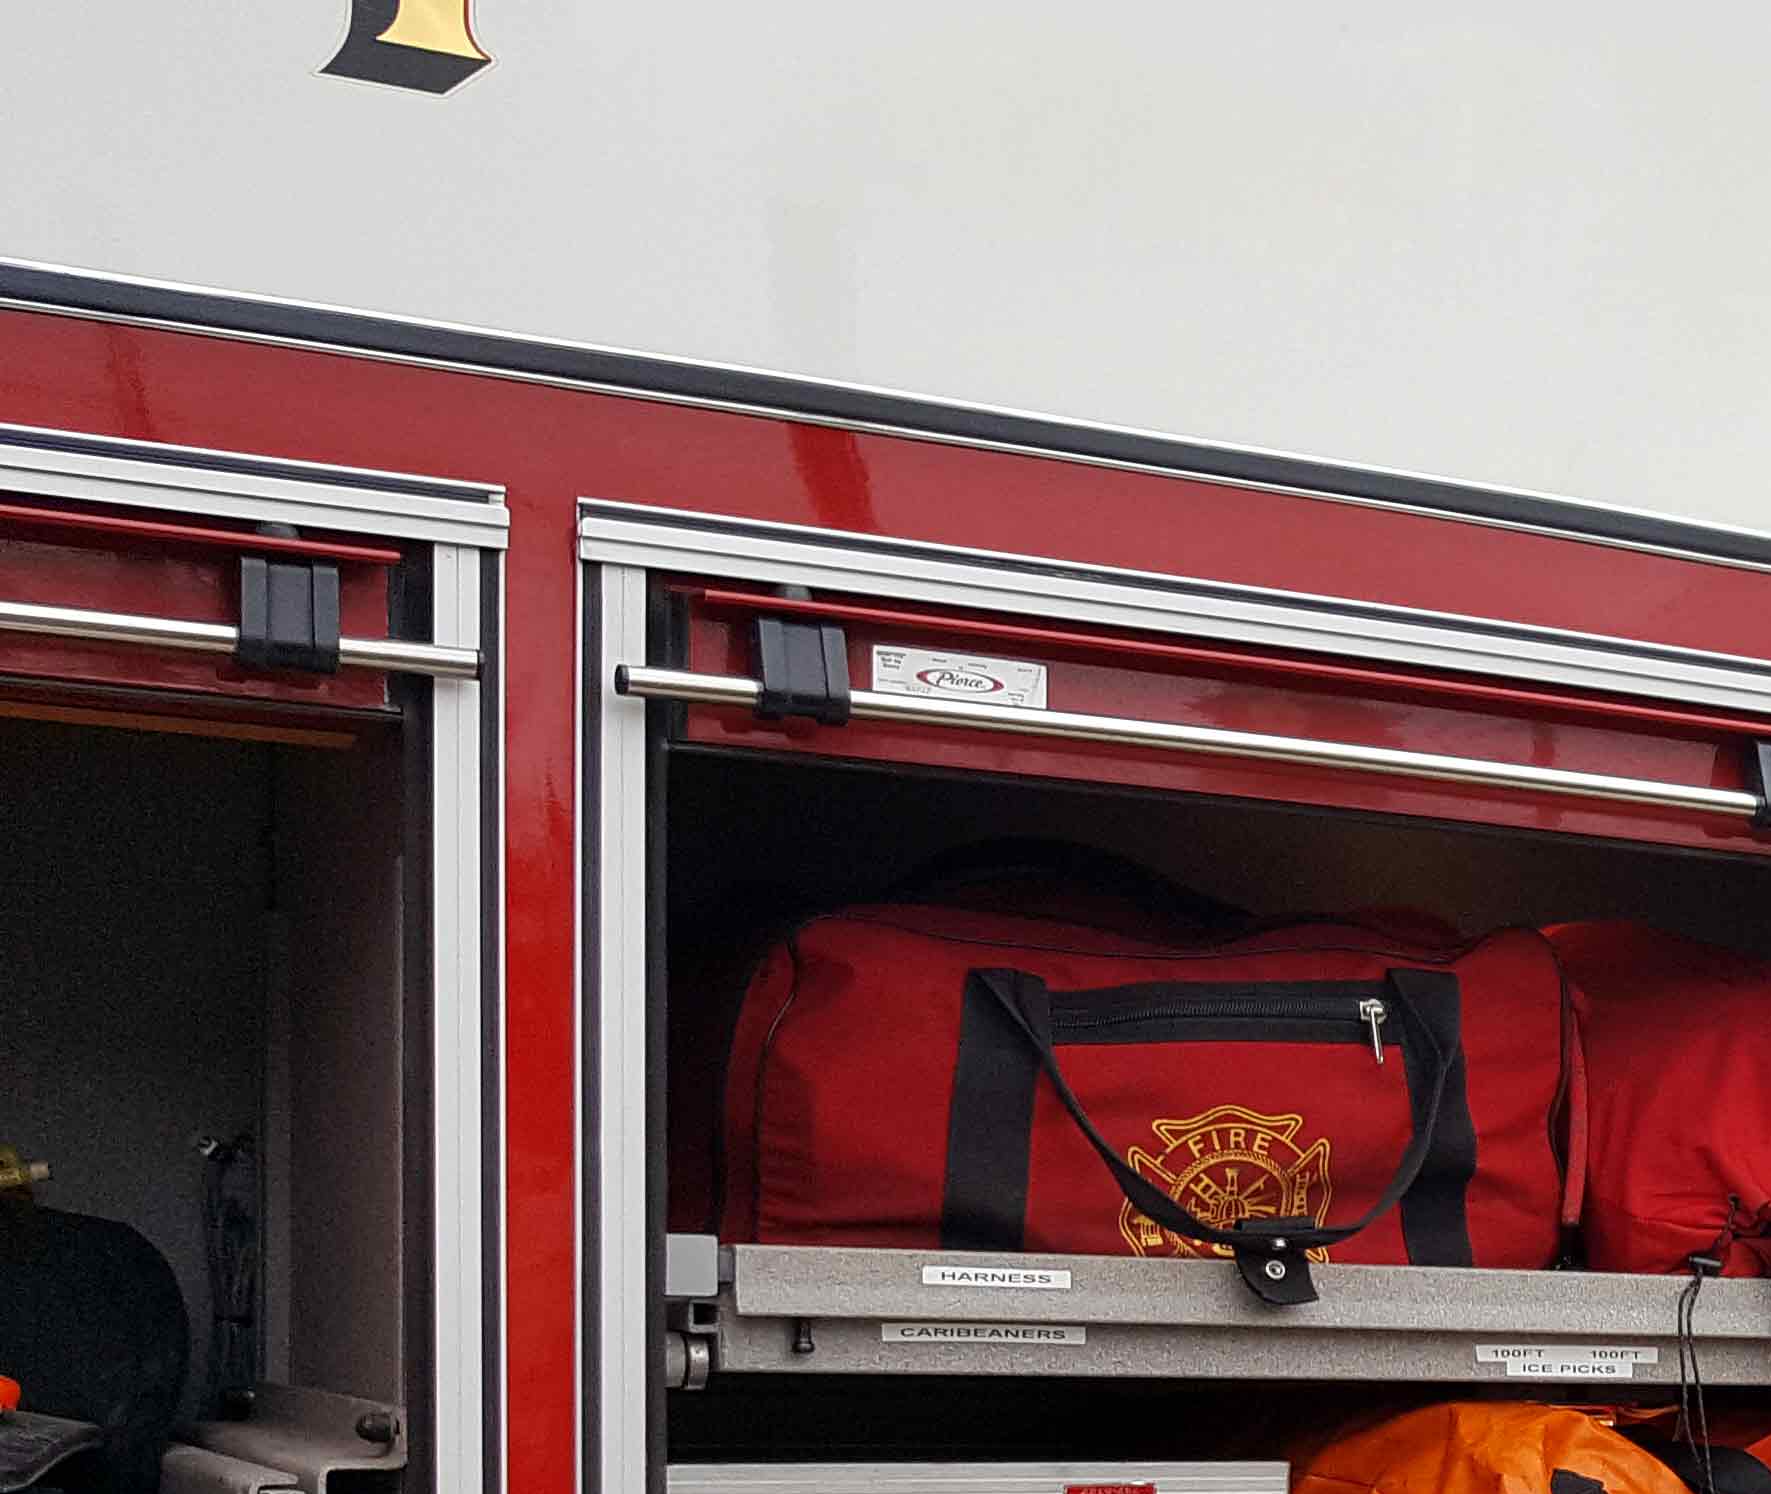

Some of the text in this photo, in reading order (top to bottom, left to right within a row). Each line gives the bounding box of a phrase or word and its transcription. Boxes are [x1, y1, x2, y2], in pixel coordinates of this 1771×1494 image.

[936, 672, 984, 690] Pierce
[1187, 1128, 1273, 1158] FIRE
[940, 1271, 1052, 1284] HARNESS
[899, 1327, 1067, 1340] CARIBEANERS
[1492, 1349, 1641, 1360] 100FT 100FT
[1522, 1363, 1617, 1375] ICE PICKS
